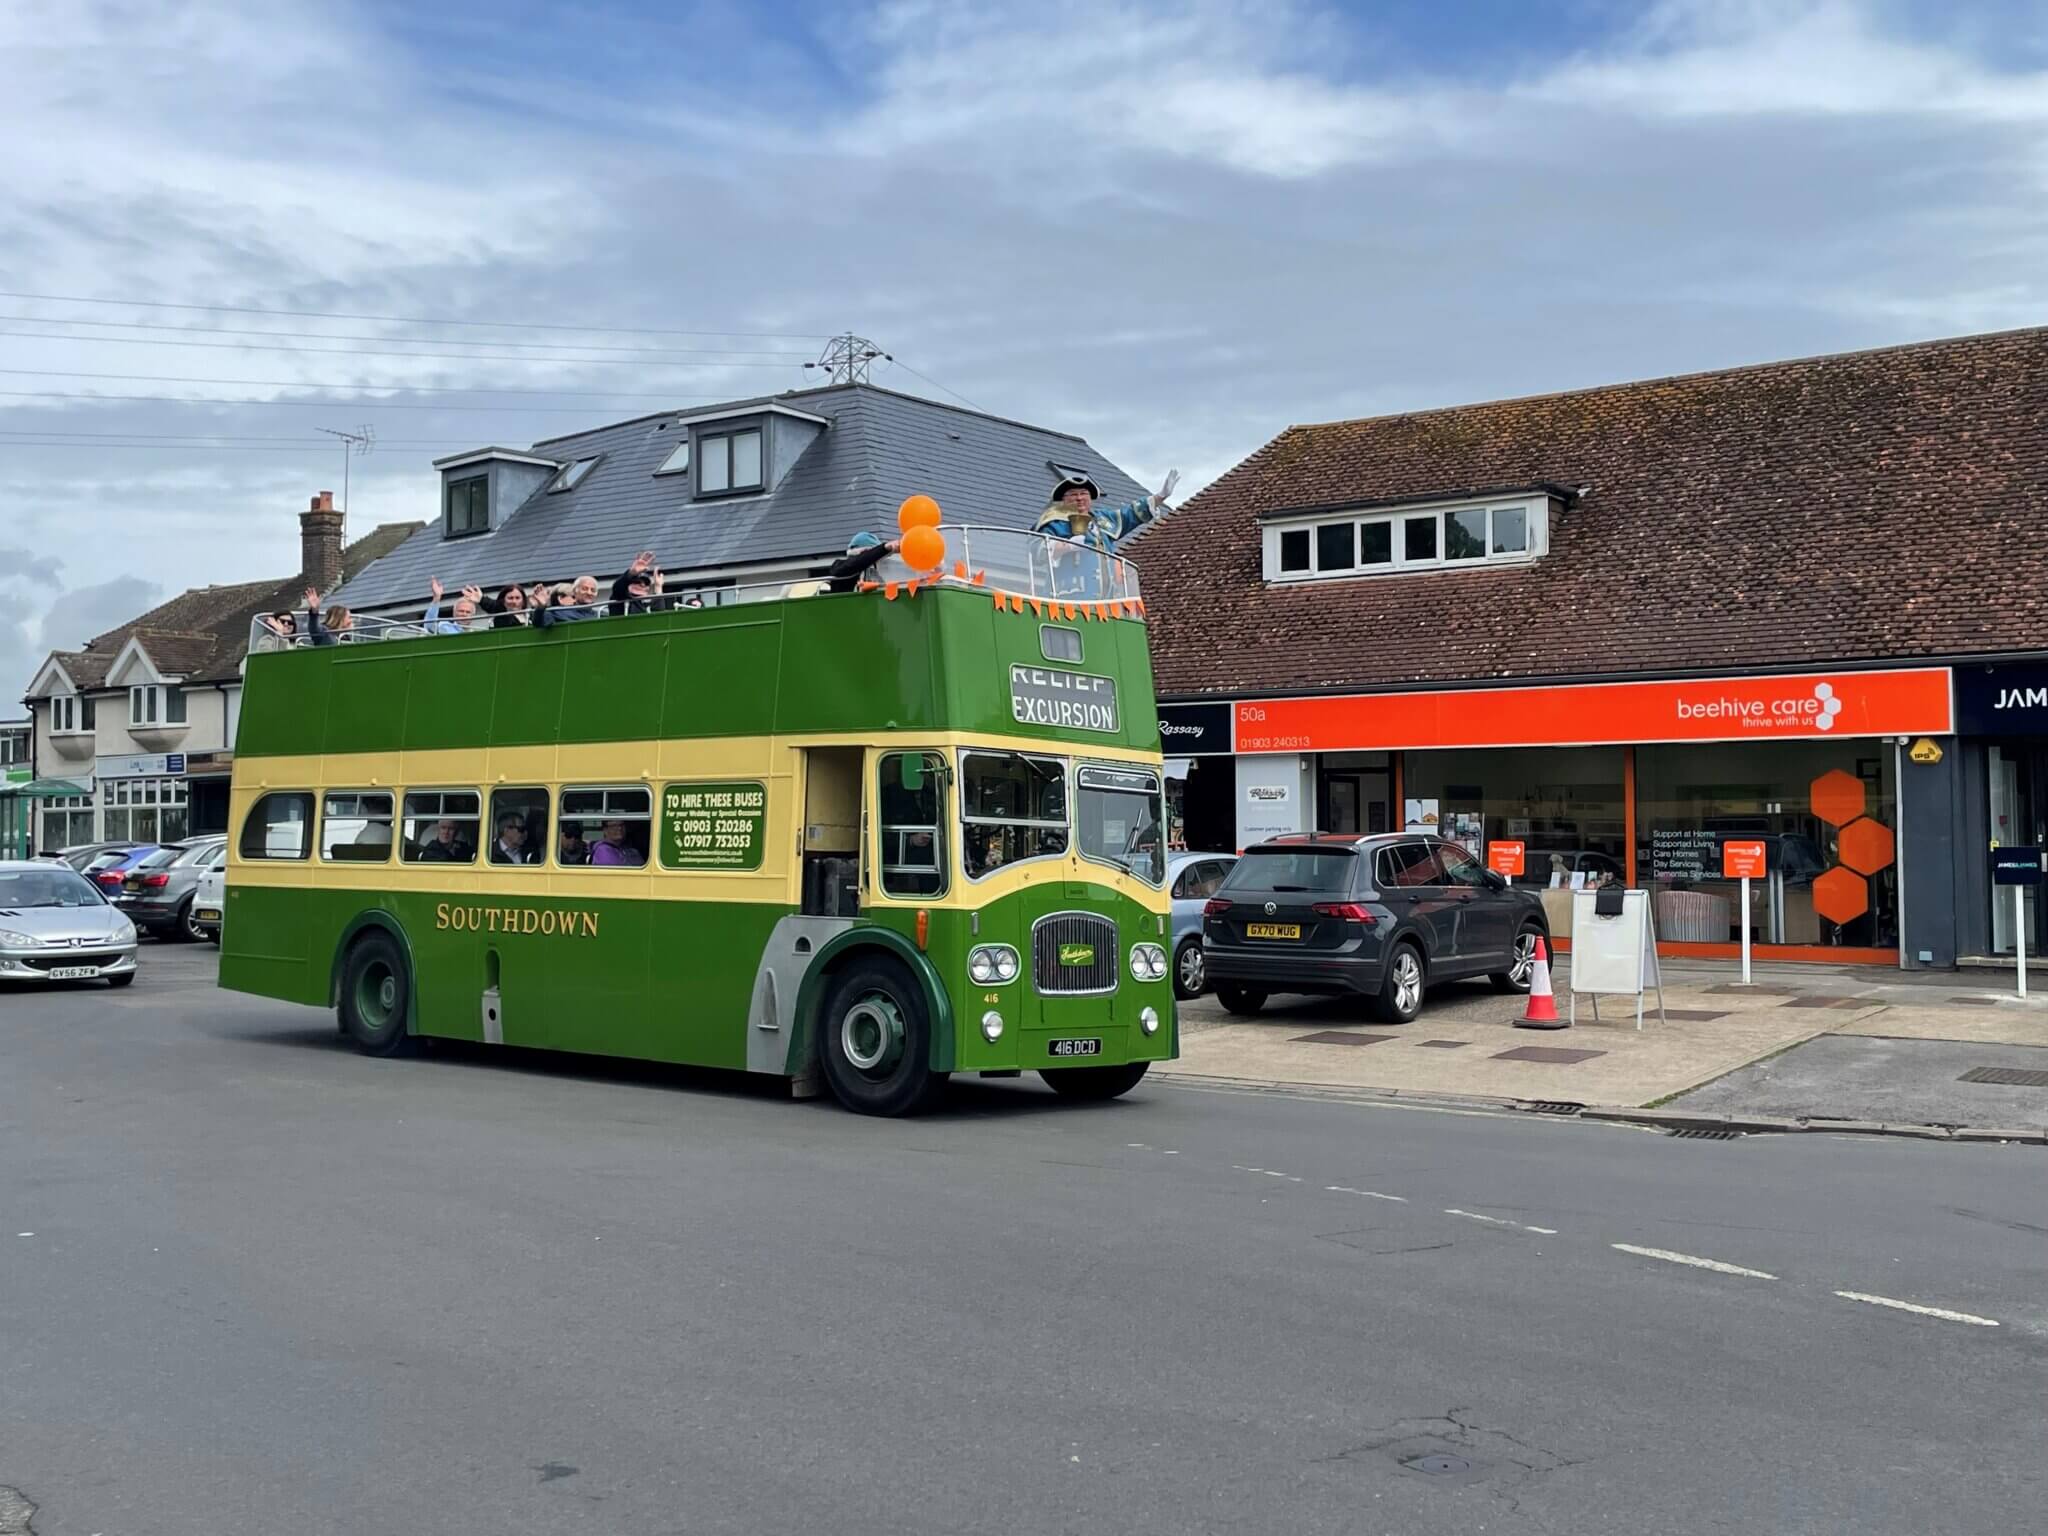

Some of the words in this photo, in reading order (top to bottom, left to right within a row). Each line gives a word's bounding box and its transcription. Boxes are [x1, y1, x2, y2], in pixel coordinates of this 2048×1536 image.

[1012, 667, 1105, 692] RELIEF
[1994, 687, 2048, 708] JAM
[1013, 695, 1113, 729] EXCURSION
[1240, 707, 1266, 721] 50a
[1677, 697, 1765, 719] beehive
[1771, 698, 1819, 715] care
[1742, 717, 1773, 728] thrive
[1775, 715, 1799, 727] with
[1802, 717, 1814, 726] us
[1158, 720, 1204, 738] Rassasy
[1241, 738, 1271, 748] 01903
[1273, 736, 1310, 747] 240313
[666, 794, 679, 809] TO
[681, 793, 702, 808] HIRE
[704, 793, 733, 808] THESE
[734, 791, 763, 807] BUSES
[683, 820, 711, 833] 01903
[715, 820, 753, 833] 520286
[1653, 830, 1682, 839] Support
[1684, 830, 1691, 838] at
[1693, 830, 1716, 838] Home
[683, 835, 712, 848] 07917
[715, 835, 751, 848] 752053
[1653, 840, 1691, 849] Supported
[1693, 840, 1715, 849] Living
[1653, 860, 1667, 869] Day
[1669, 860, 1703, 868] Services
[1689, 871, 1721, 879] Services
[436, 903, 599, 937] SOUTHDOWN
[1250, 926, 1275, 936] GX70
[983, 993, 999, 1003] 416
